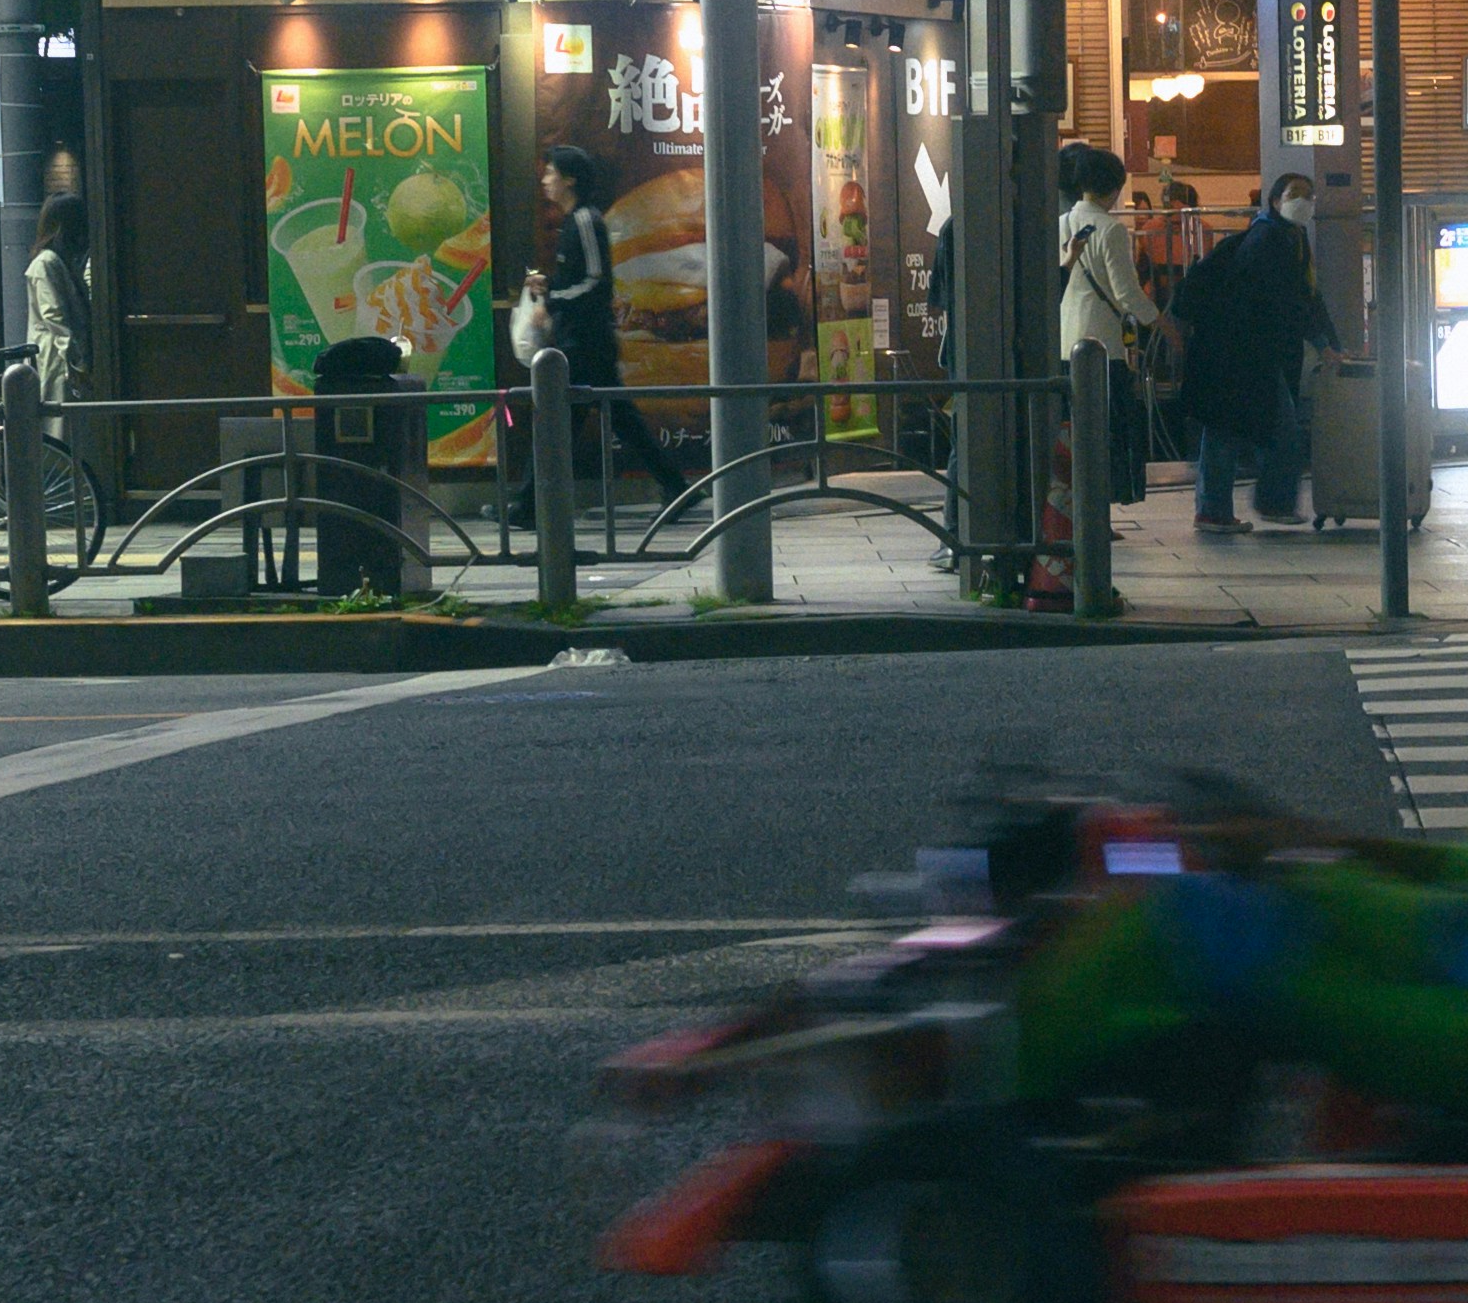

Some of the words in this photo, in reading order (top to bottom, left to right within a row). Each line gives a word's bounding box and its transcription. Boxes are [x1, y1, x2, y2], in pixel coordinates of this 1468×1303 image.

[1292, 24, 1307, 120] LOTTERIA
[1322, 24, 1336, 120] LOTTERIA
[905, 57, 956, 116] B1F
[342, 93, 413, 107] ロッテリアの
[1286, 130, 1308, 142] B1F
[653, 141, 704, 156] Ultimate
[906, 253, 924, 267] OPEN
[907, 303, 928, 318] CLOSE
[299, 334, 320, 346] 290
[453, 404, 476, 416] 390
